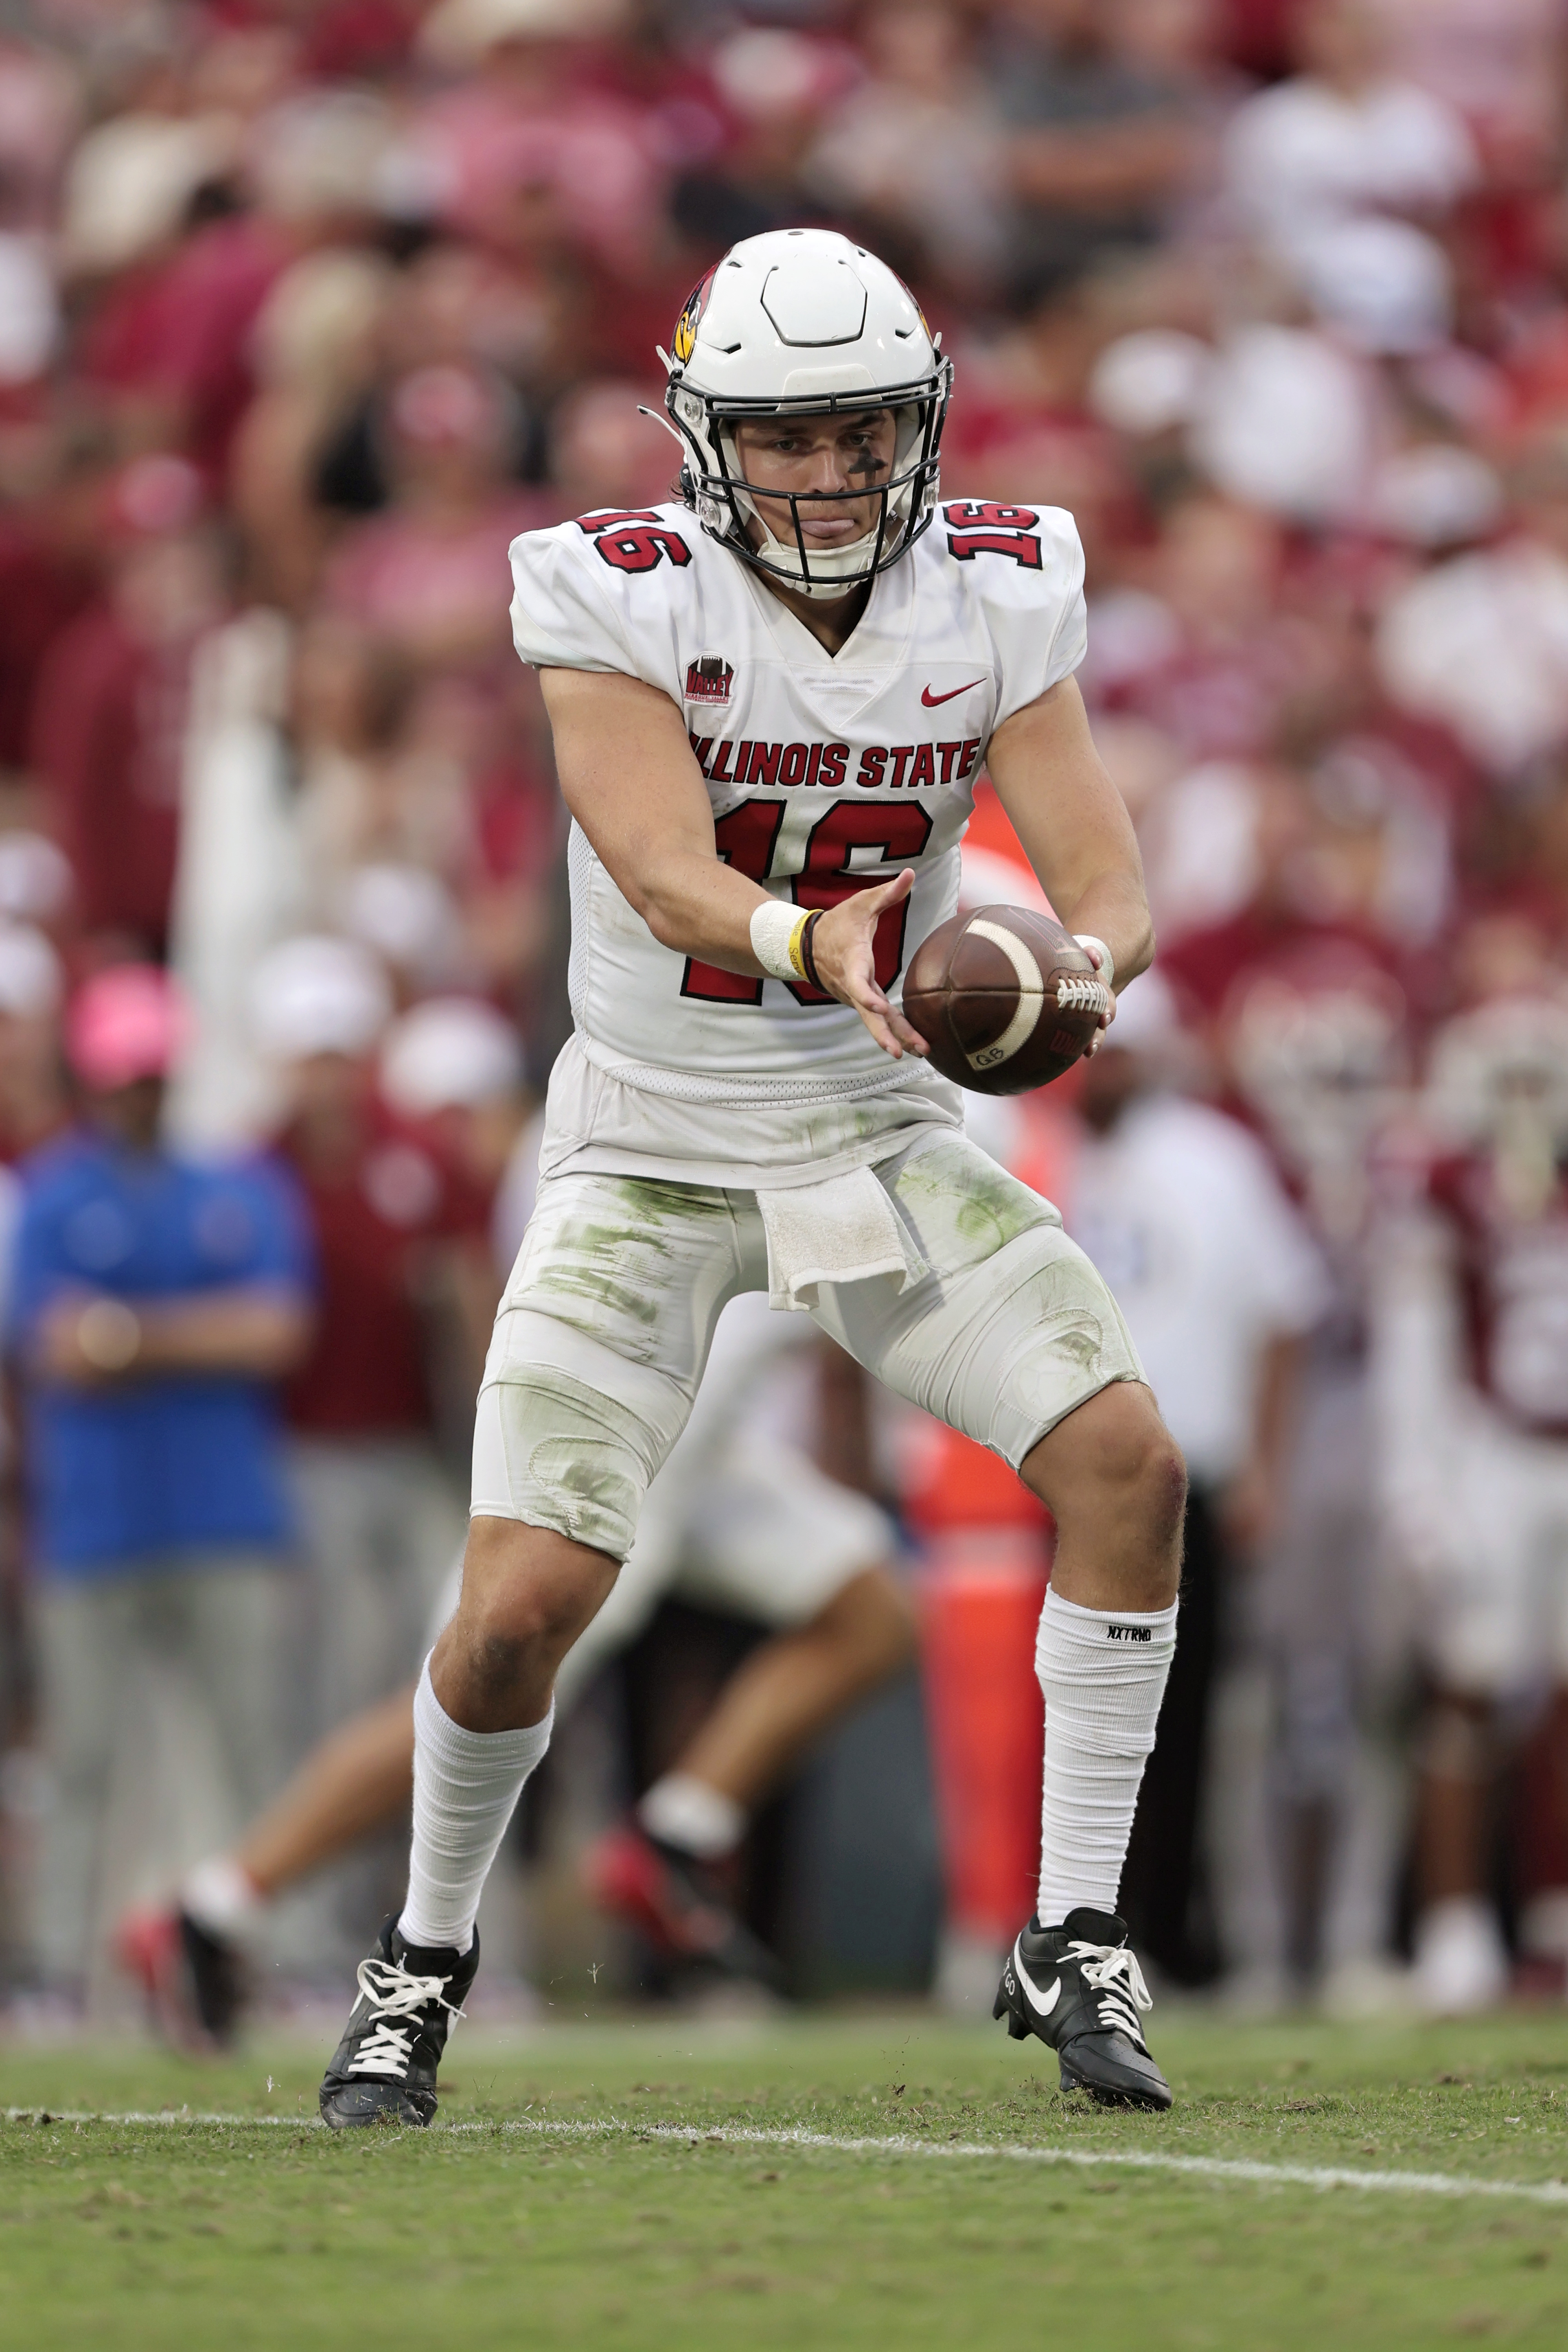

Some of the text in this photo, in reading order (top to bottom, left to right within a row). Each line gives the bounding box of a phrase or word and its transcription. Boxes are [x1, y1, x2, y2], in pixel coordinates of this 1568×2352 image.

[575, 511, 692, 574] 16
[942, 503, 1042, 570] 16
[686, 666, 734, 697] VALLEY
[857, 737, 982, 788] STATE
[680, 798, 934, 1006] 16
[976, 1048, 1004, 1065] QB
[1107, 1626, 1151, 1642] NXTRND
